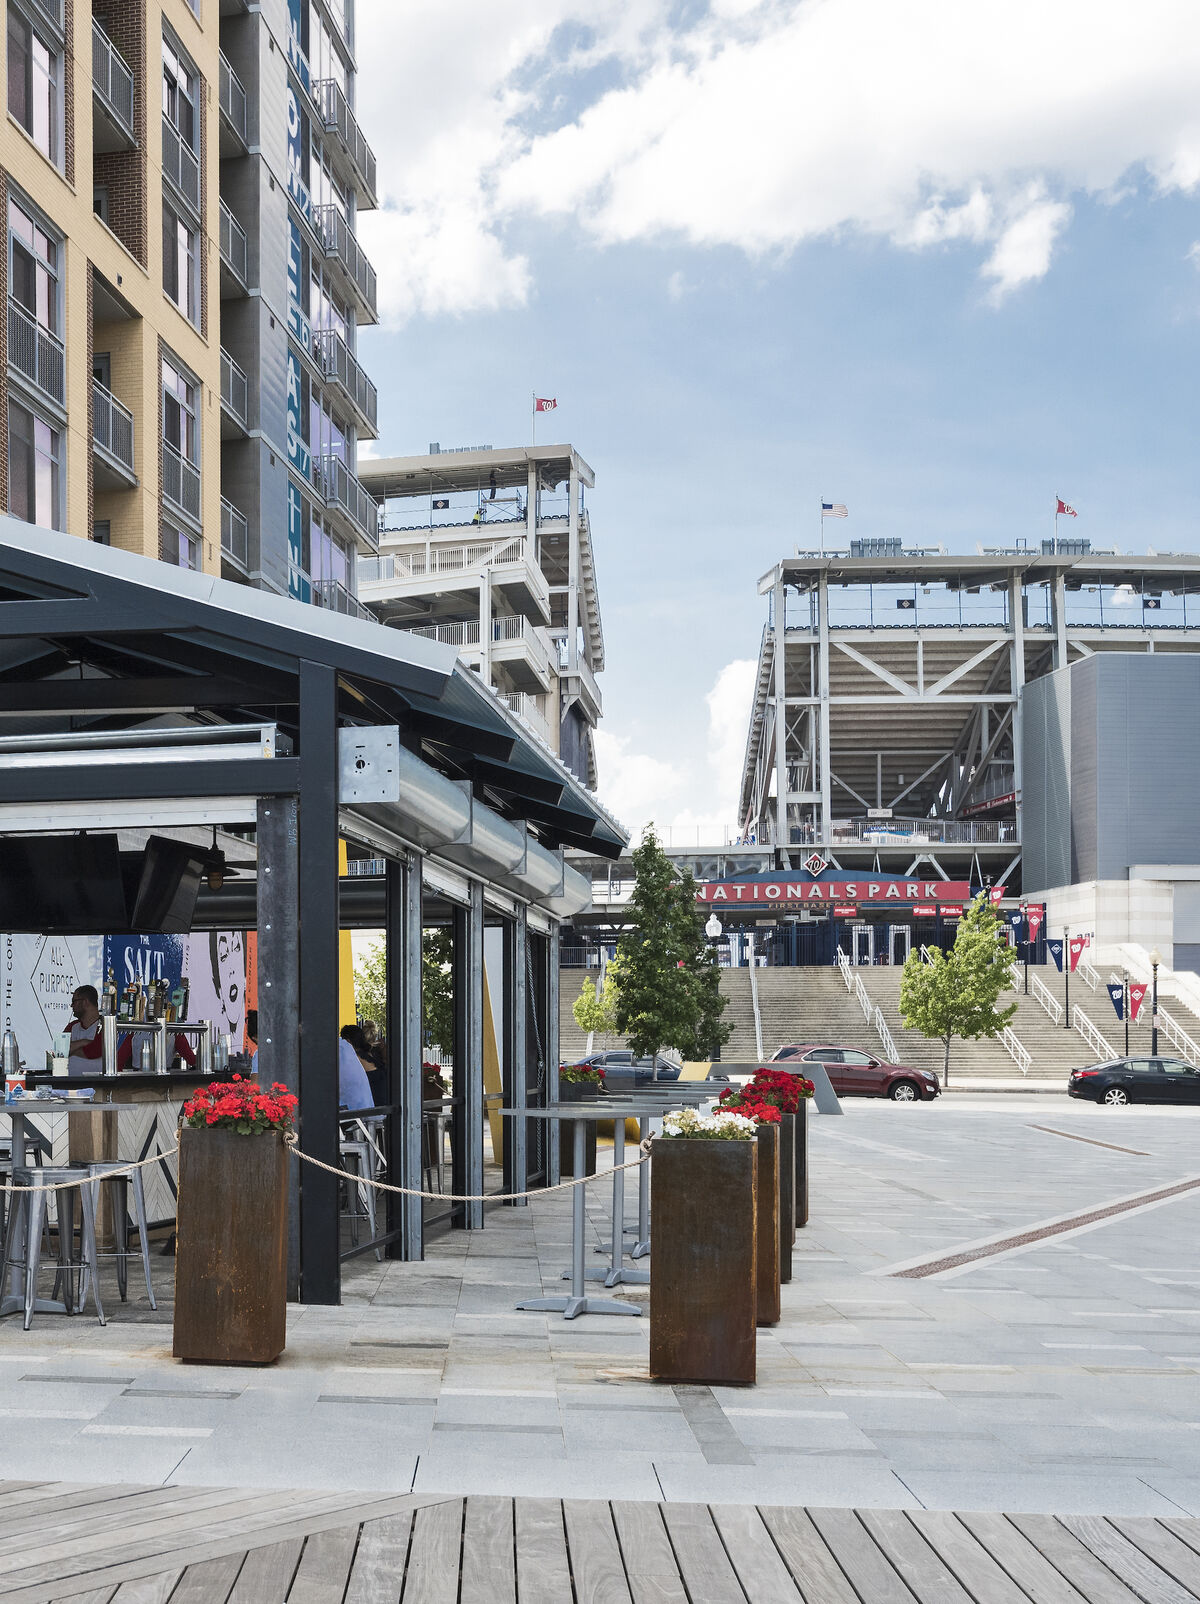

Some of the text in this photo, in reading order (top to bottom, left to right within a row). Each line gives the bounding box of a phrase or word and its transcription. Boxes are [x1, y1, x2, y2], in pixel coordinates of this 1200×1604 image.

[694, 883, 938, 900] NATIONALS PARK
[124, 946, 166, 986] SALT
[39, 972, 75, 995] PURPOSE
[44, 1003, 72, 1011] WATERFRON
